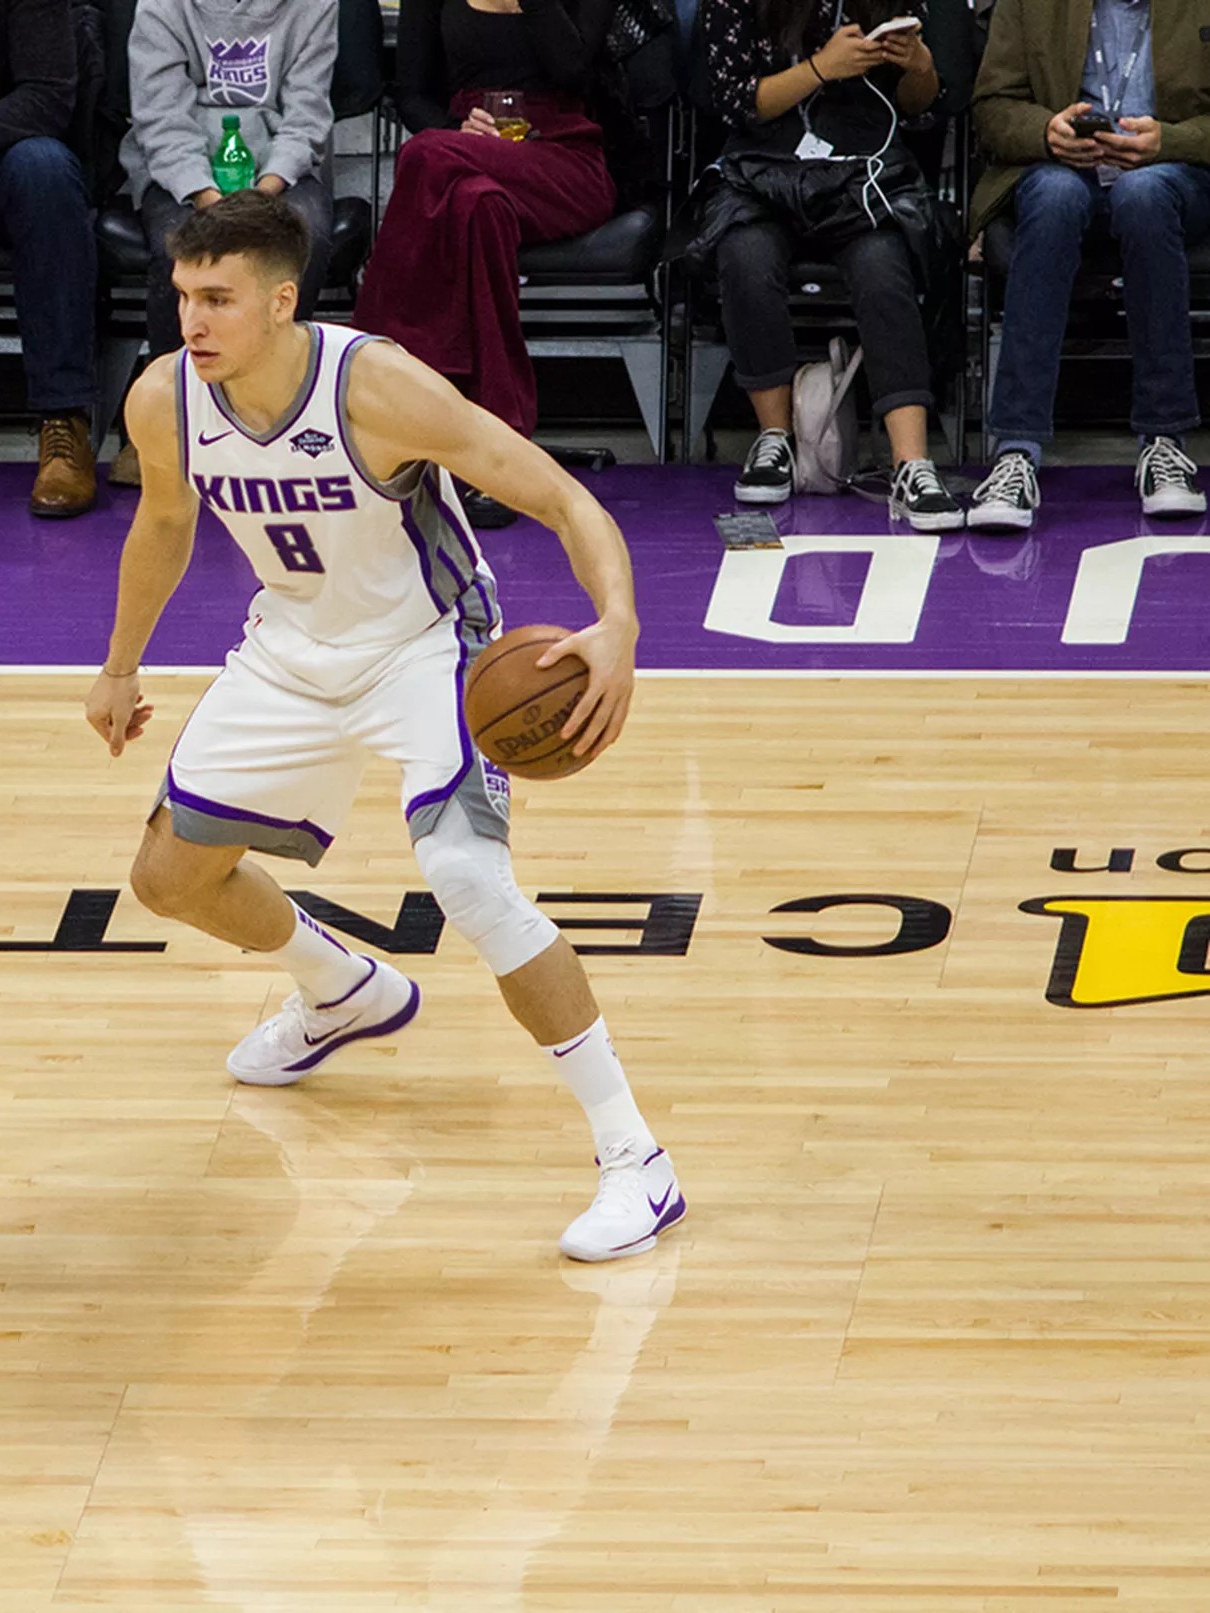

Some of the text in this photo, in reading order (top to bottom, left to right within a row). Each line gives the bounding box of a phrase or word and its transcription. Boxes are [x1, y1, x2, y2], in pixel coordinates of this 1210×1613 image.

[210, 64, 266, 83] KINGS
[192, 474, 357, 513] KINGS
[263, 523, 326, 574] 8
